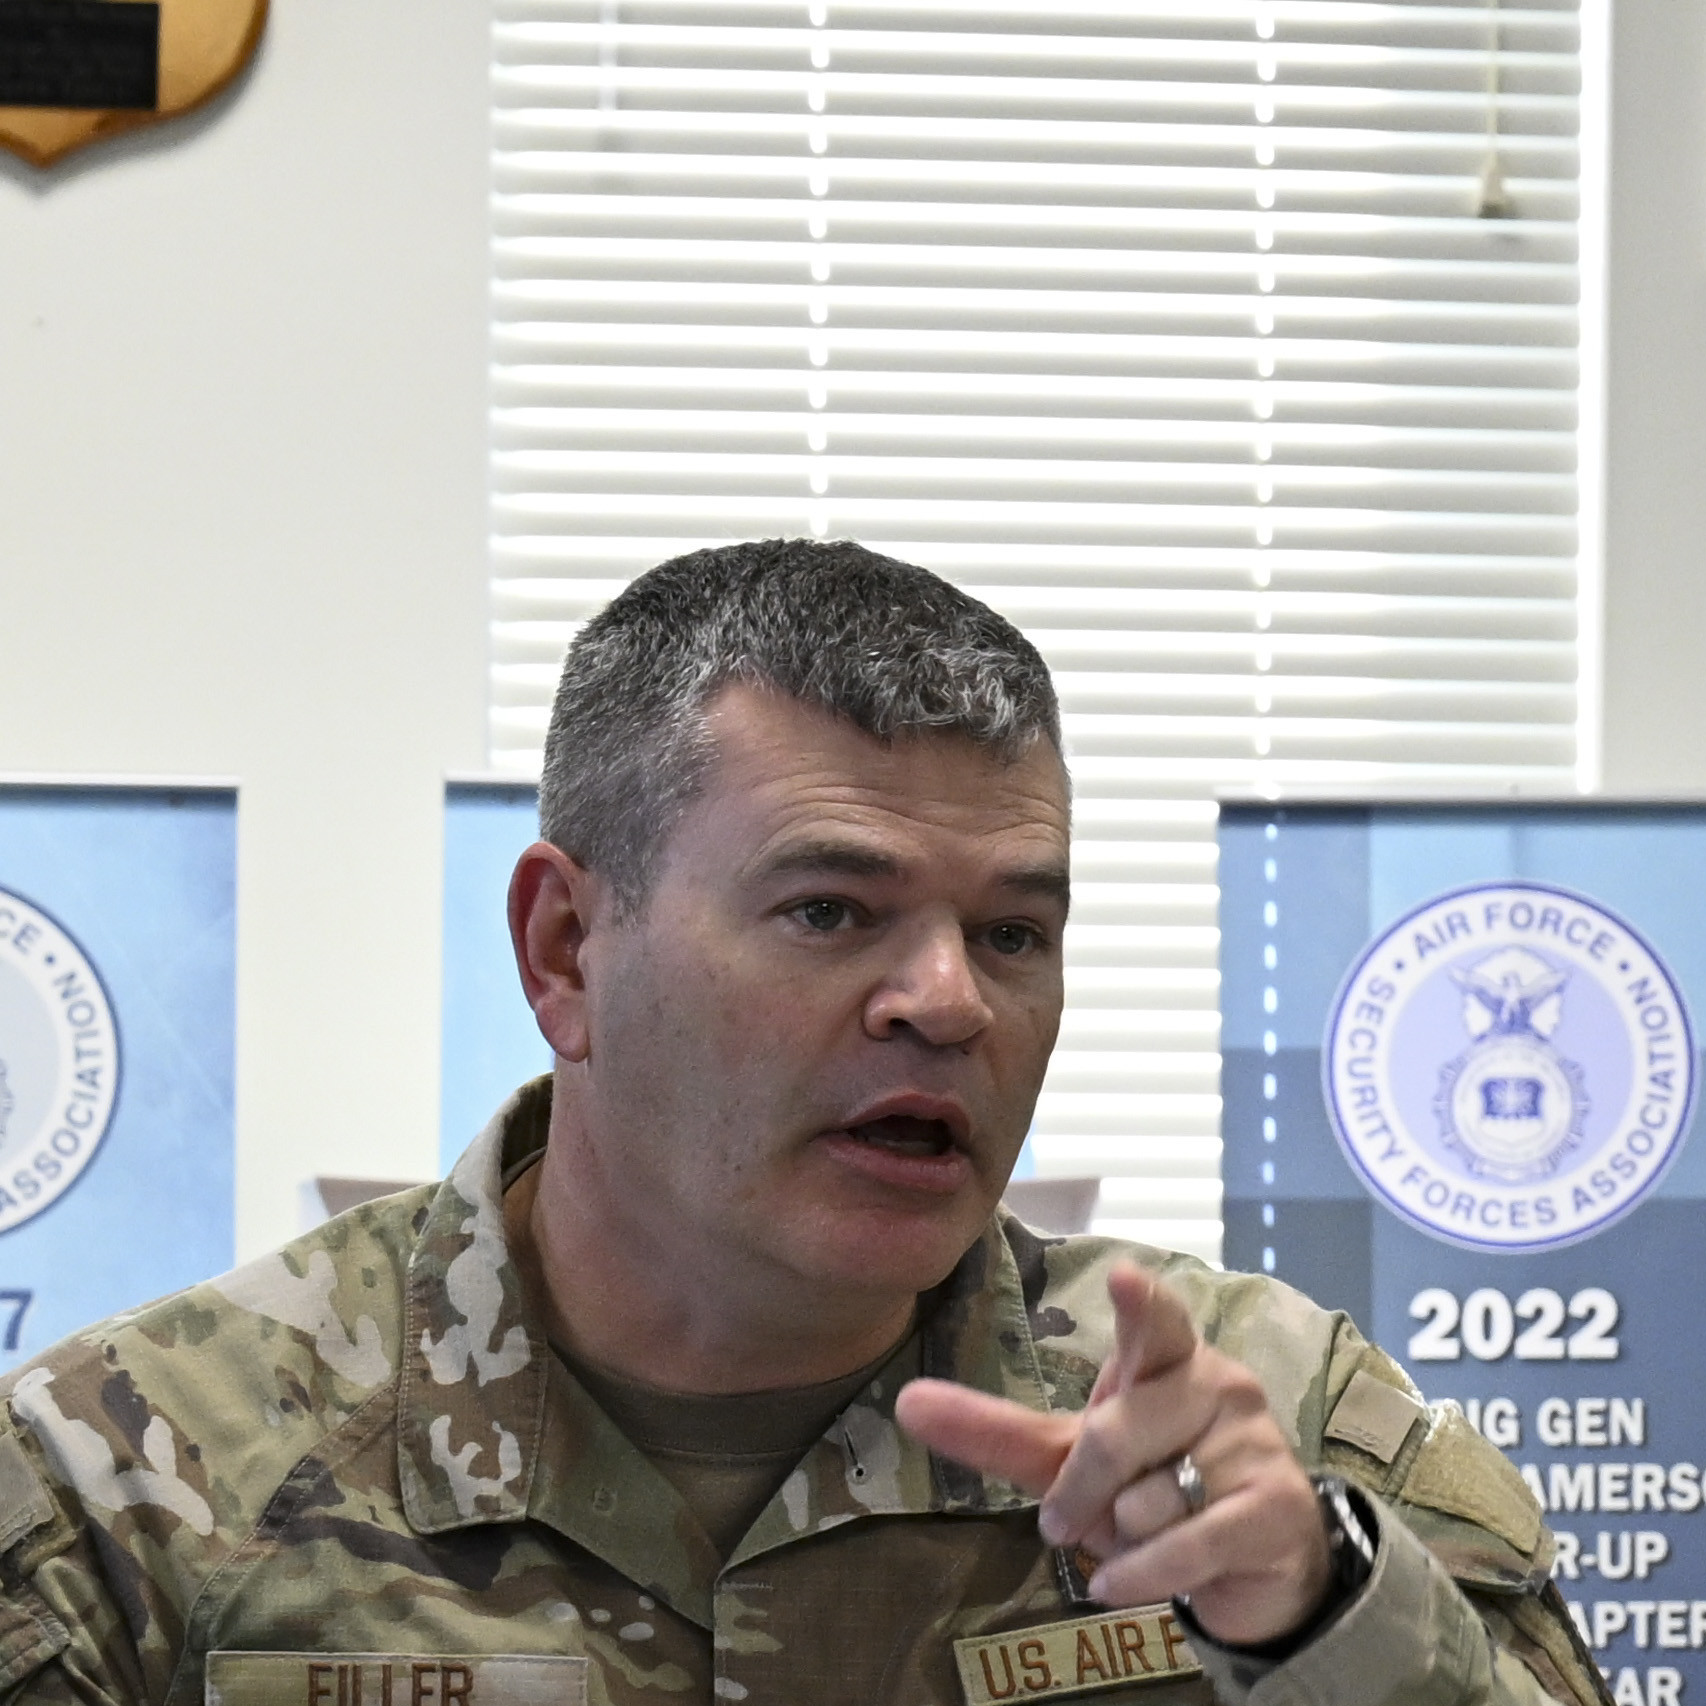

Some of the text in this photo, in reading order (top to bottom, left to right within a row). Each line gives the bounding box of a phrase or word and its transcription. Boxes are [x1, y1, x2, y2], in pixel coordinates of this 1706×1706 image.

[1412, 900, 1617, 958] AIR FORCE
[1346, 972, 1675, 1229] SECURITY FORCES ASSOCIATION
[1408, 1287, 1619, 1361] 2022
[1536, 1398, 1645, 1447] GEN
[978, 1638, 1063, 1700] U.S.
[1076, 1620, 1155, 1686] AIR
